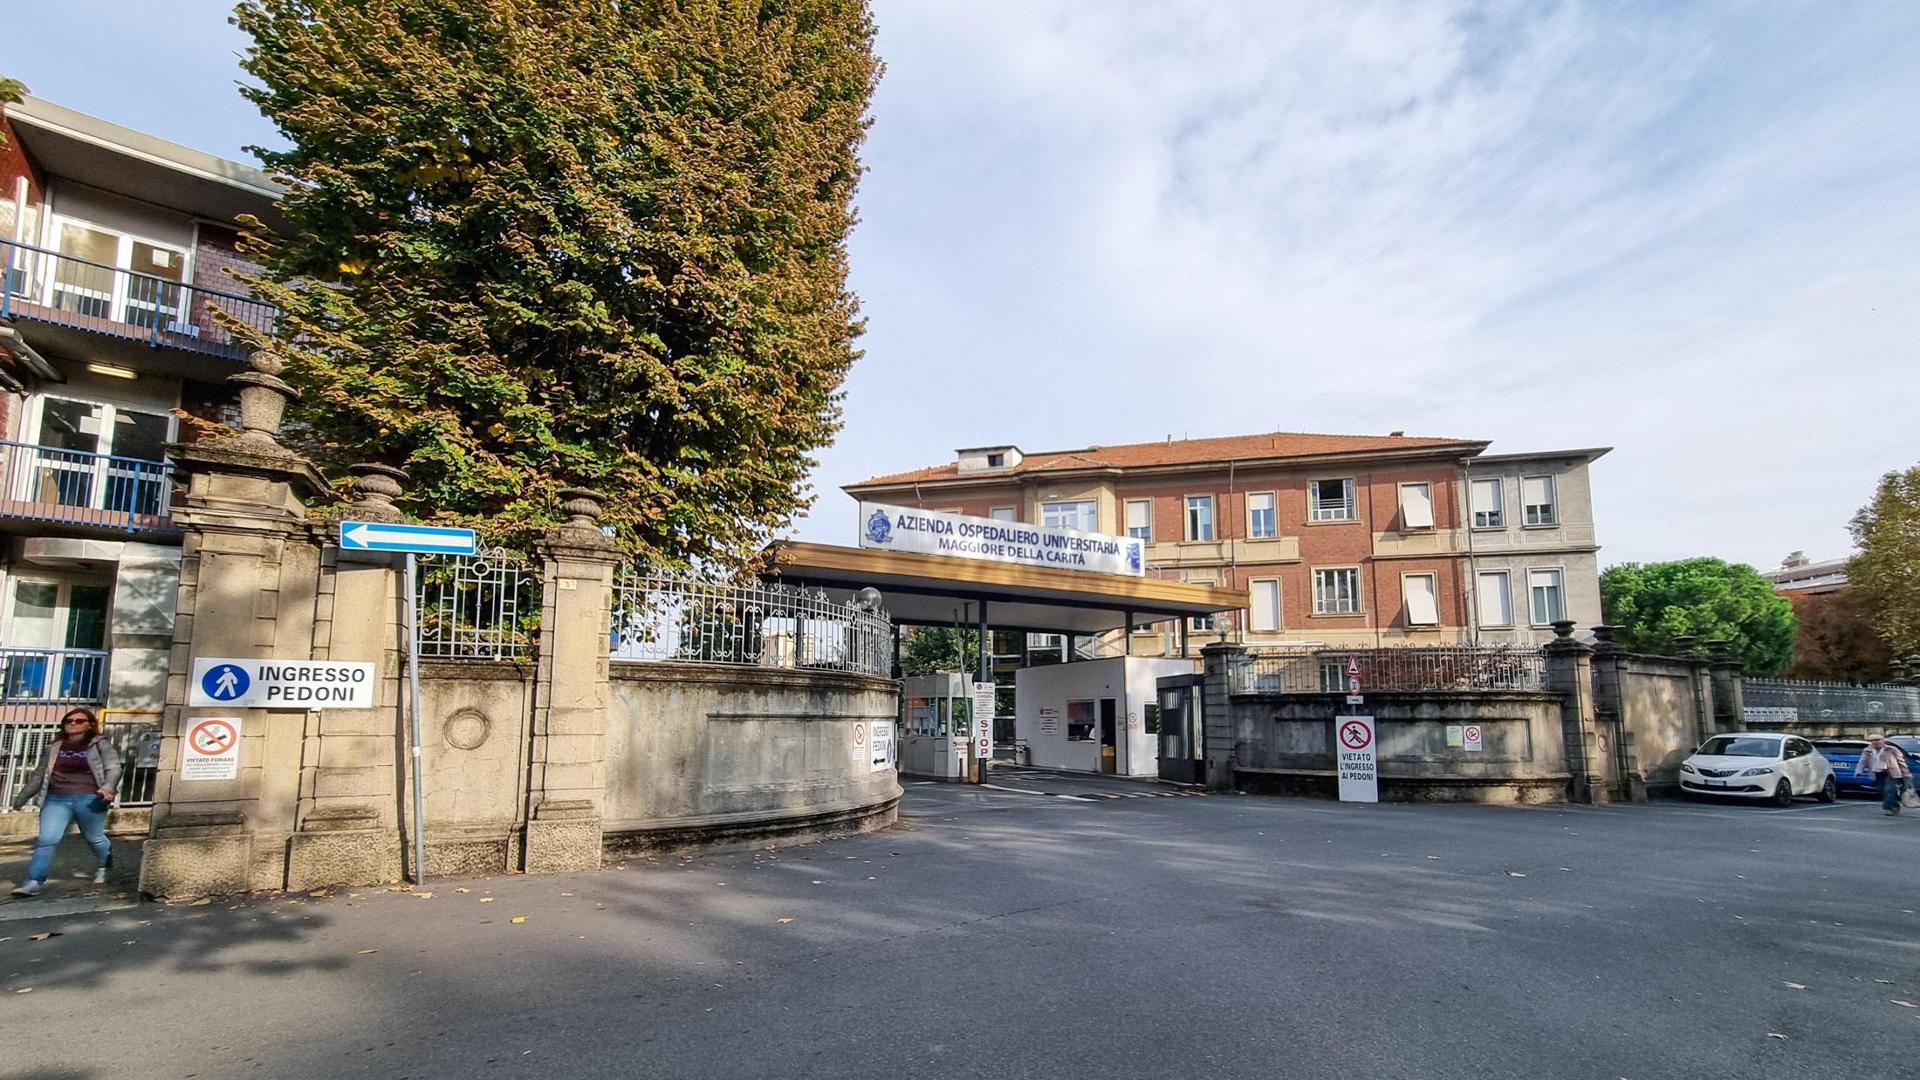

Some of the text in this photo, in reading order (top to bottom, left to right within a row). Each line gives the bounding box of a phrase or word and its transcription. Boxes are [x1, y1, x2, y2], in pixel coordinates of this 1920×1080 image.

[896, 514, 1120, 555] AZIENDA OSPEDALIERO UNIVERSITARIA
[938, 537, 1004, 556] MAGGIORE
[1008, 545, 1043, 561] DELLA
[258, 666, 366, 683] INGRESSO
[267, 686, 355, 702] PEDONI
[980, 719, 988, 757] STOP
[1341, 753, 1371, 761] VIETATO
[1340, 763, 1374, 771] L'INGRESSO
[1342, 772, 1374, 781] AI PEDONI
